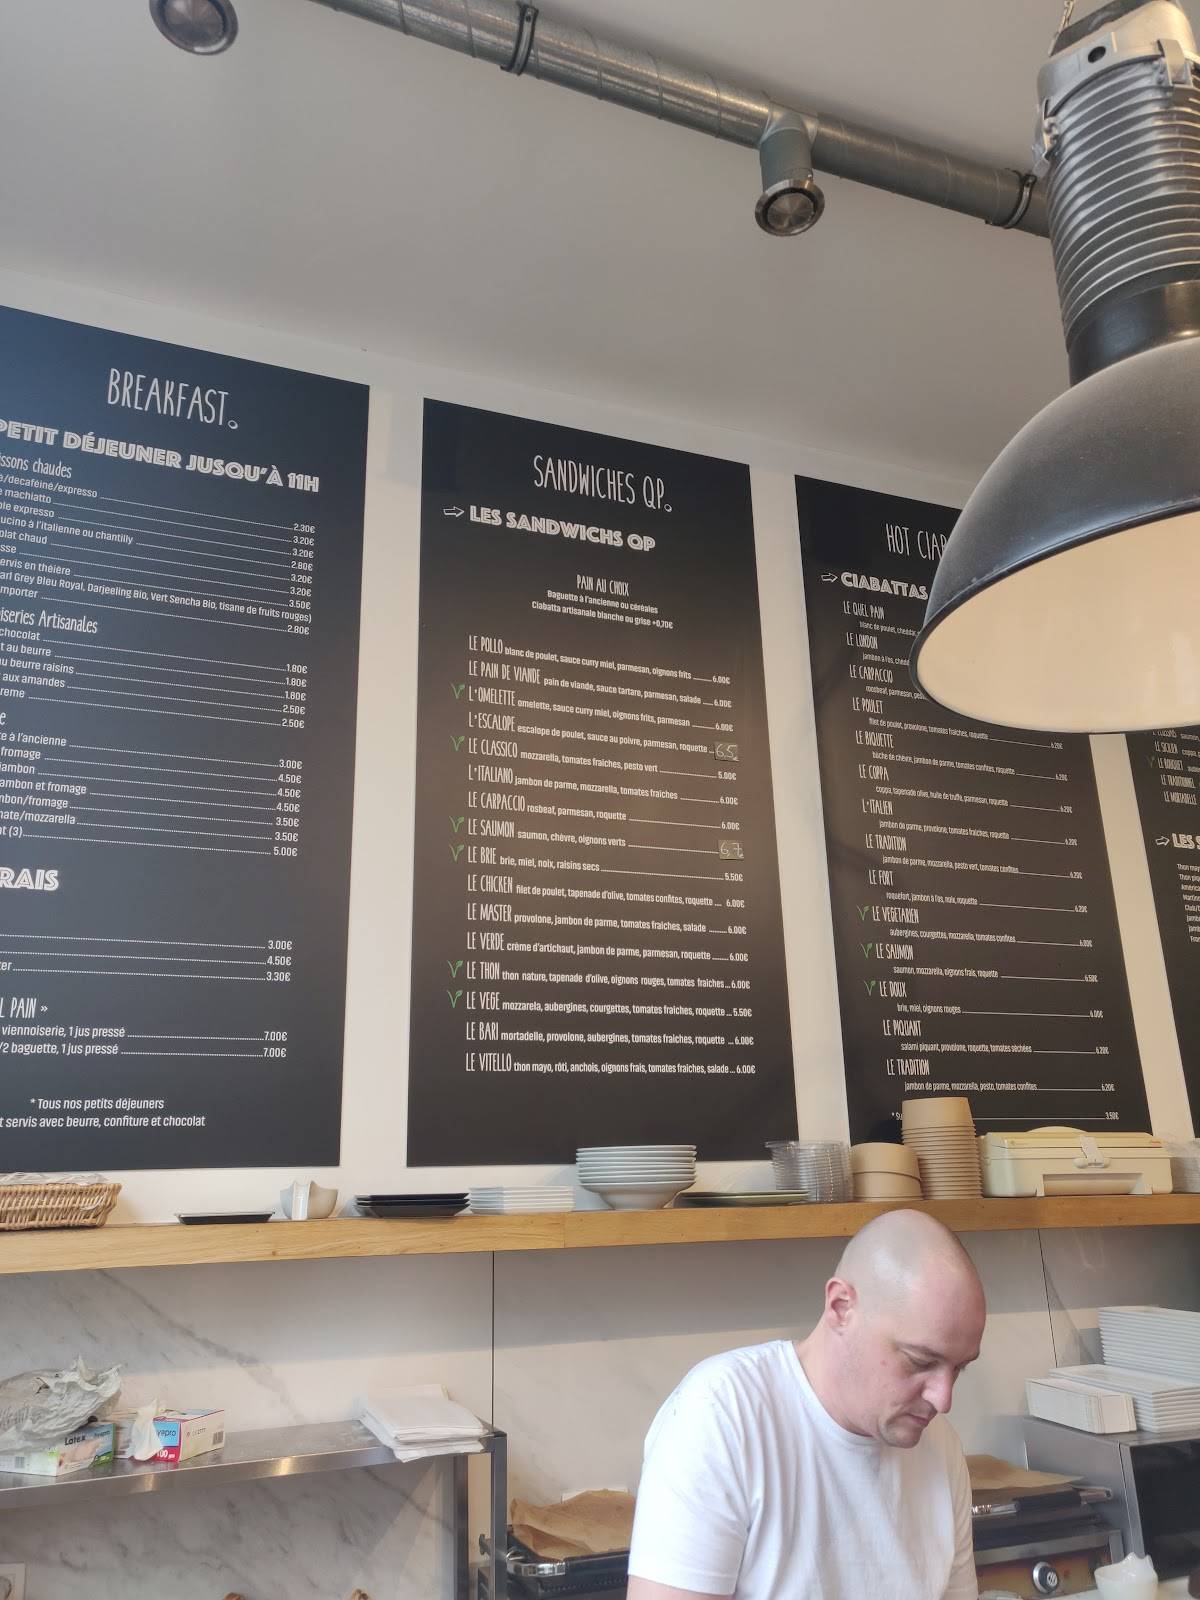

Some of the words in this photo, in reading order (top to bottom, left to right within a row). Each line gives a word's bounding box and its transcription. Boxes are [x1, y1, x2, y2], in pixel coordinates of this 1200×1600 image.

[32, 458, 72, 478] chaudes
[63, 431, 181, 468] DÉJEUNER
[187, 454, 283, 486] JUSQU'À
[287, 472, 319, 492] 11H
[534, 455, 635, 504] SANDWICHES
[5, 489, 51, 503] machiatto
[293, 535, 314, 546] 3.20€
[470, 505, 502, 525] LES
[506, 512, 623, 547] SANDWICHS
[627, 533, 655, 551] QP
[14, 504, 54, 517] expresso
[292, 548, 314, 558] 3.20€
[18, 532, 47, 544] chaud
[291, 573, 312, 584] 3.20€
[577, 574, 593, 590] PAIN
[596, 578, 606, 593] AU
[609, 580, 629, 596] CHOIX
[14, 572, 35, 584] Grey
[36, 576, 57, 586] Bleu
[87, 583, 131, 598] Darjeeling
[151, 592, 168, 602] Vert
[169, 595, 200, 606] Sencha
[219, 602, 244, 612] tisane
[246, 605, 256, 614] de
[259, 607, 280, 617] fruits
[281, 611, 311, 623] rouges)
[547, 590, 578, 601] Baguette
[585, 595, 619, 608] l'ancienne
[38, 610, 97, 633] Artisanales
[532, 601, 561, 612] Ciabatta
[562, 606, 596, 617] artisanale
[597, 610, 624, 621] blanche
[634, 617, 651, 625] grise
[469, 635, 478, 651] LE
[481, 636, 503, 654] POLLO
[6, 644, 18, 652] au
[20, 644, 51, 656] beurre
[286, 677, 306, 687] 1.80€
[469, 660, 477, 676] LE
[481, 661, 498, 678] PAIN
[502, 664, 510, 680] DE
[513, 666, 540, 684] VIANDE
[10, 658, 41, 670] beurre
[43, 662, 74, 674] raisins
[285, 691, 306, 701] 1.80€
[469, 686, 515, 706] L'OMELETTE
[469, 711, 515, 732] L'ESCALOPE
[9, 732, 15, 741] à
[17, 732, 66, 746] l'ancienne
[279, 759, 302, 769] 3.00€
[469, 738, 477, 754] LE
[481, 739, 517, 758] CLASSICO
[1, 746, 41, 760] fromage
[278, 774, 301, 783] 4.50€
[468, 764, 513, 784] L'ITALIANO
[35, 781, 45, 790] et
[47, 781, 86, 795] fromage
[276, 802, 300, 812] 4.50€
[468, 791, 477, 807] LE
[480, 792, 525, 812] CARPACCIO
[468, 818, 477, 835] LE
[480, 819, 514, 837] SAUMON
[468, 846, 477, 863] LE
[480, 846, 496, 864] BRIE
[556, 860, 581, 870] raisins
[582, 863, 599, 871] secs
[724, 872, 743, 881] 5.50€
[468, 874, 477, 891] LE
[480, 875, 512, 893] CHICKEN
[467, 903, 476, 920] LE
[480, 904, 511, 922] MASTER
[268, 940, 292, 950] 3.00€
[467, 932, 476, 949] LE
[480, 932, 504, 950] VERDE
[267, 955, 291, 965] 4.50€
[467, 961, 476, 979] LE
[480, 961, 499, 979] THON
[266, 971, 291, 981] 3.30€
[10, 997, 36, 1018] PAIN
[467, 991, 476, 1009] LE
[479, 991, 500, 1010] VEGE
[632, 1004, 662, 1014] tomates
[695, 1007, 725, 1016] roquette
[733, 1008, 752, 1017] 5.50€
[92, 1027, 125, 1039] pressé
[264, 1031, 287, 1041] 7.00€
[466, 1021, 475, 1040] LE
[479, 1021, 498, 1040] BARI
[84, 1043, 118, 1056] pressé
[263, 1047, 286, 1057] 7.00€
[466, 1052, 475, 1071] LE
[479, 1053, 511, 1071] VITELLO
[513, 1062, 530, 1071] thon
[601, 1062, 629, 1073] oignons
[648, 1064, 676, 1072] tomates
[707, 1064, 728, 1073] salade
[736, 1065, 755, 1074] 6.00€
[38, 1099, 61, 1109] Tous
[63, 1100, 82, 1109] nos
[84, 1098, 113, 1111] petits
[115, 1098, 164, 1110] déjeuners
[5, 1116, 37, 1127] servis
[39, 1118, 64, 1127] avec
[104, 1115, 149, 1126] confiture
[151, 1116, 161, 1126] et
[163, 1116, 205, 1126] chocolat
